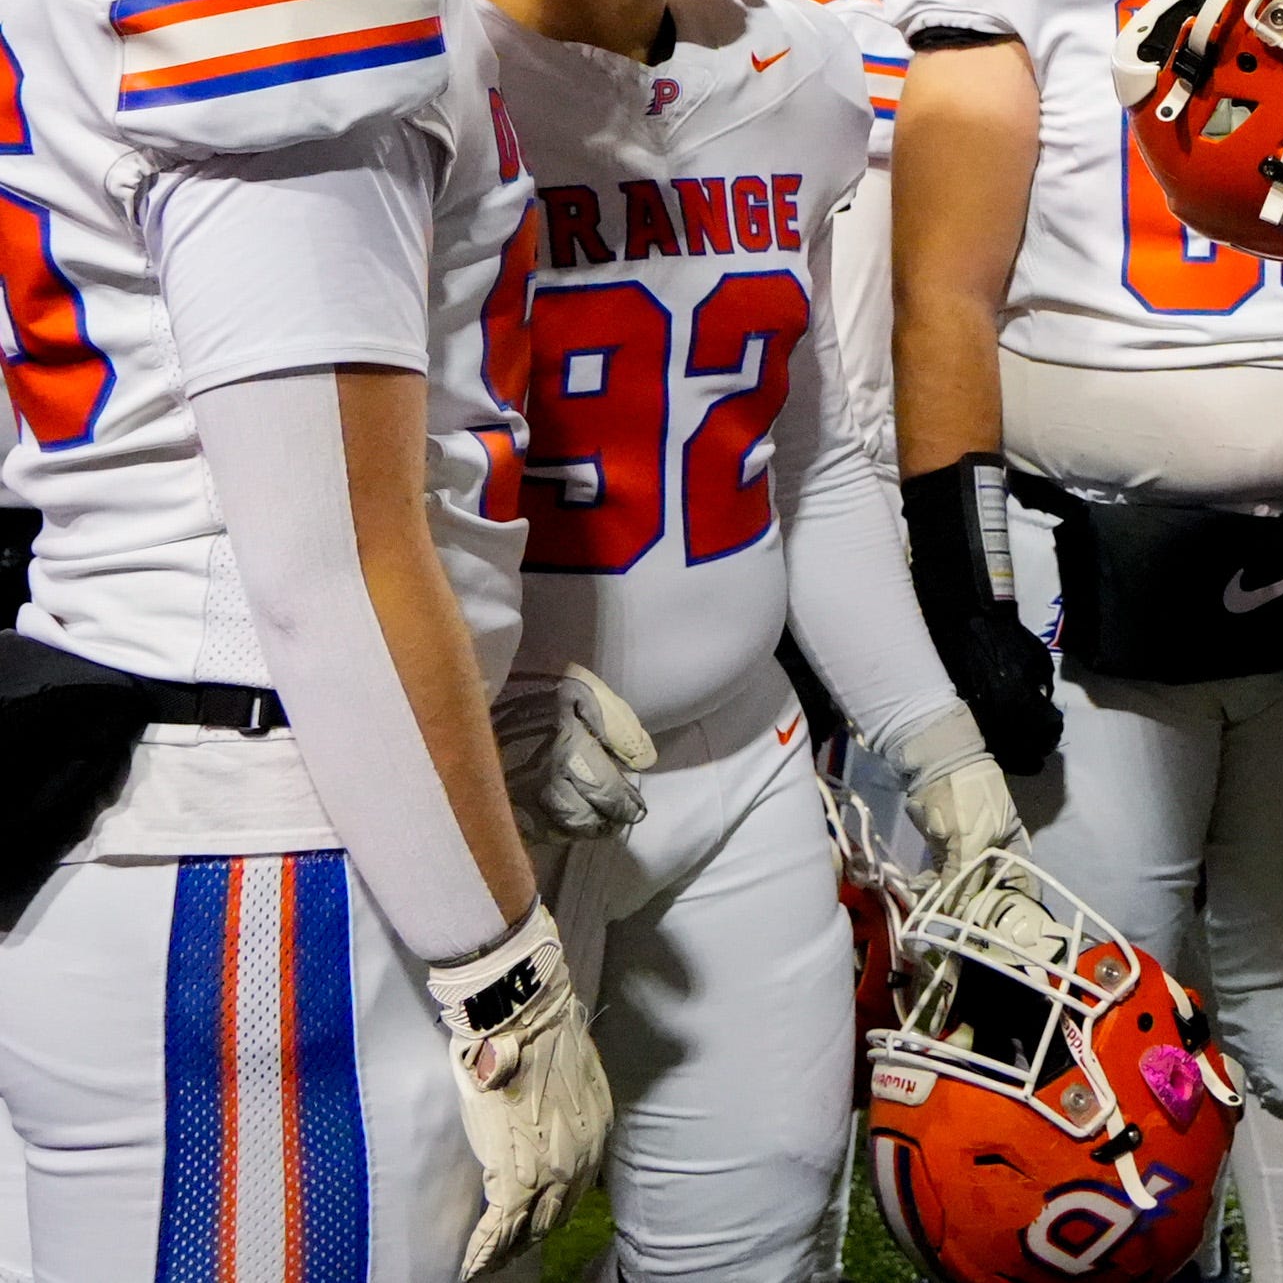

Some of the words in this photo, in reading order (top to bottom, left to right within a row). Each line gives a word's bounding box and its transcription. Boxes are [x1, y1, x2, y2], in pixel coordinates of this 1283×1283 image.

[645, 77, 681, 116] P
[538, 174, 803, 268] RANGE
[520, 269, 811, 575] 92
[463, 955, 542, 1031] NIKE
